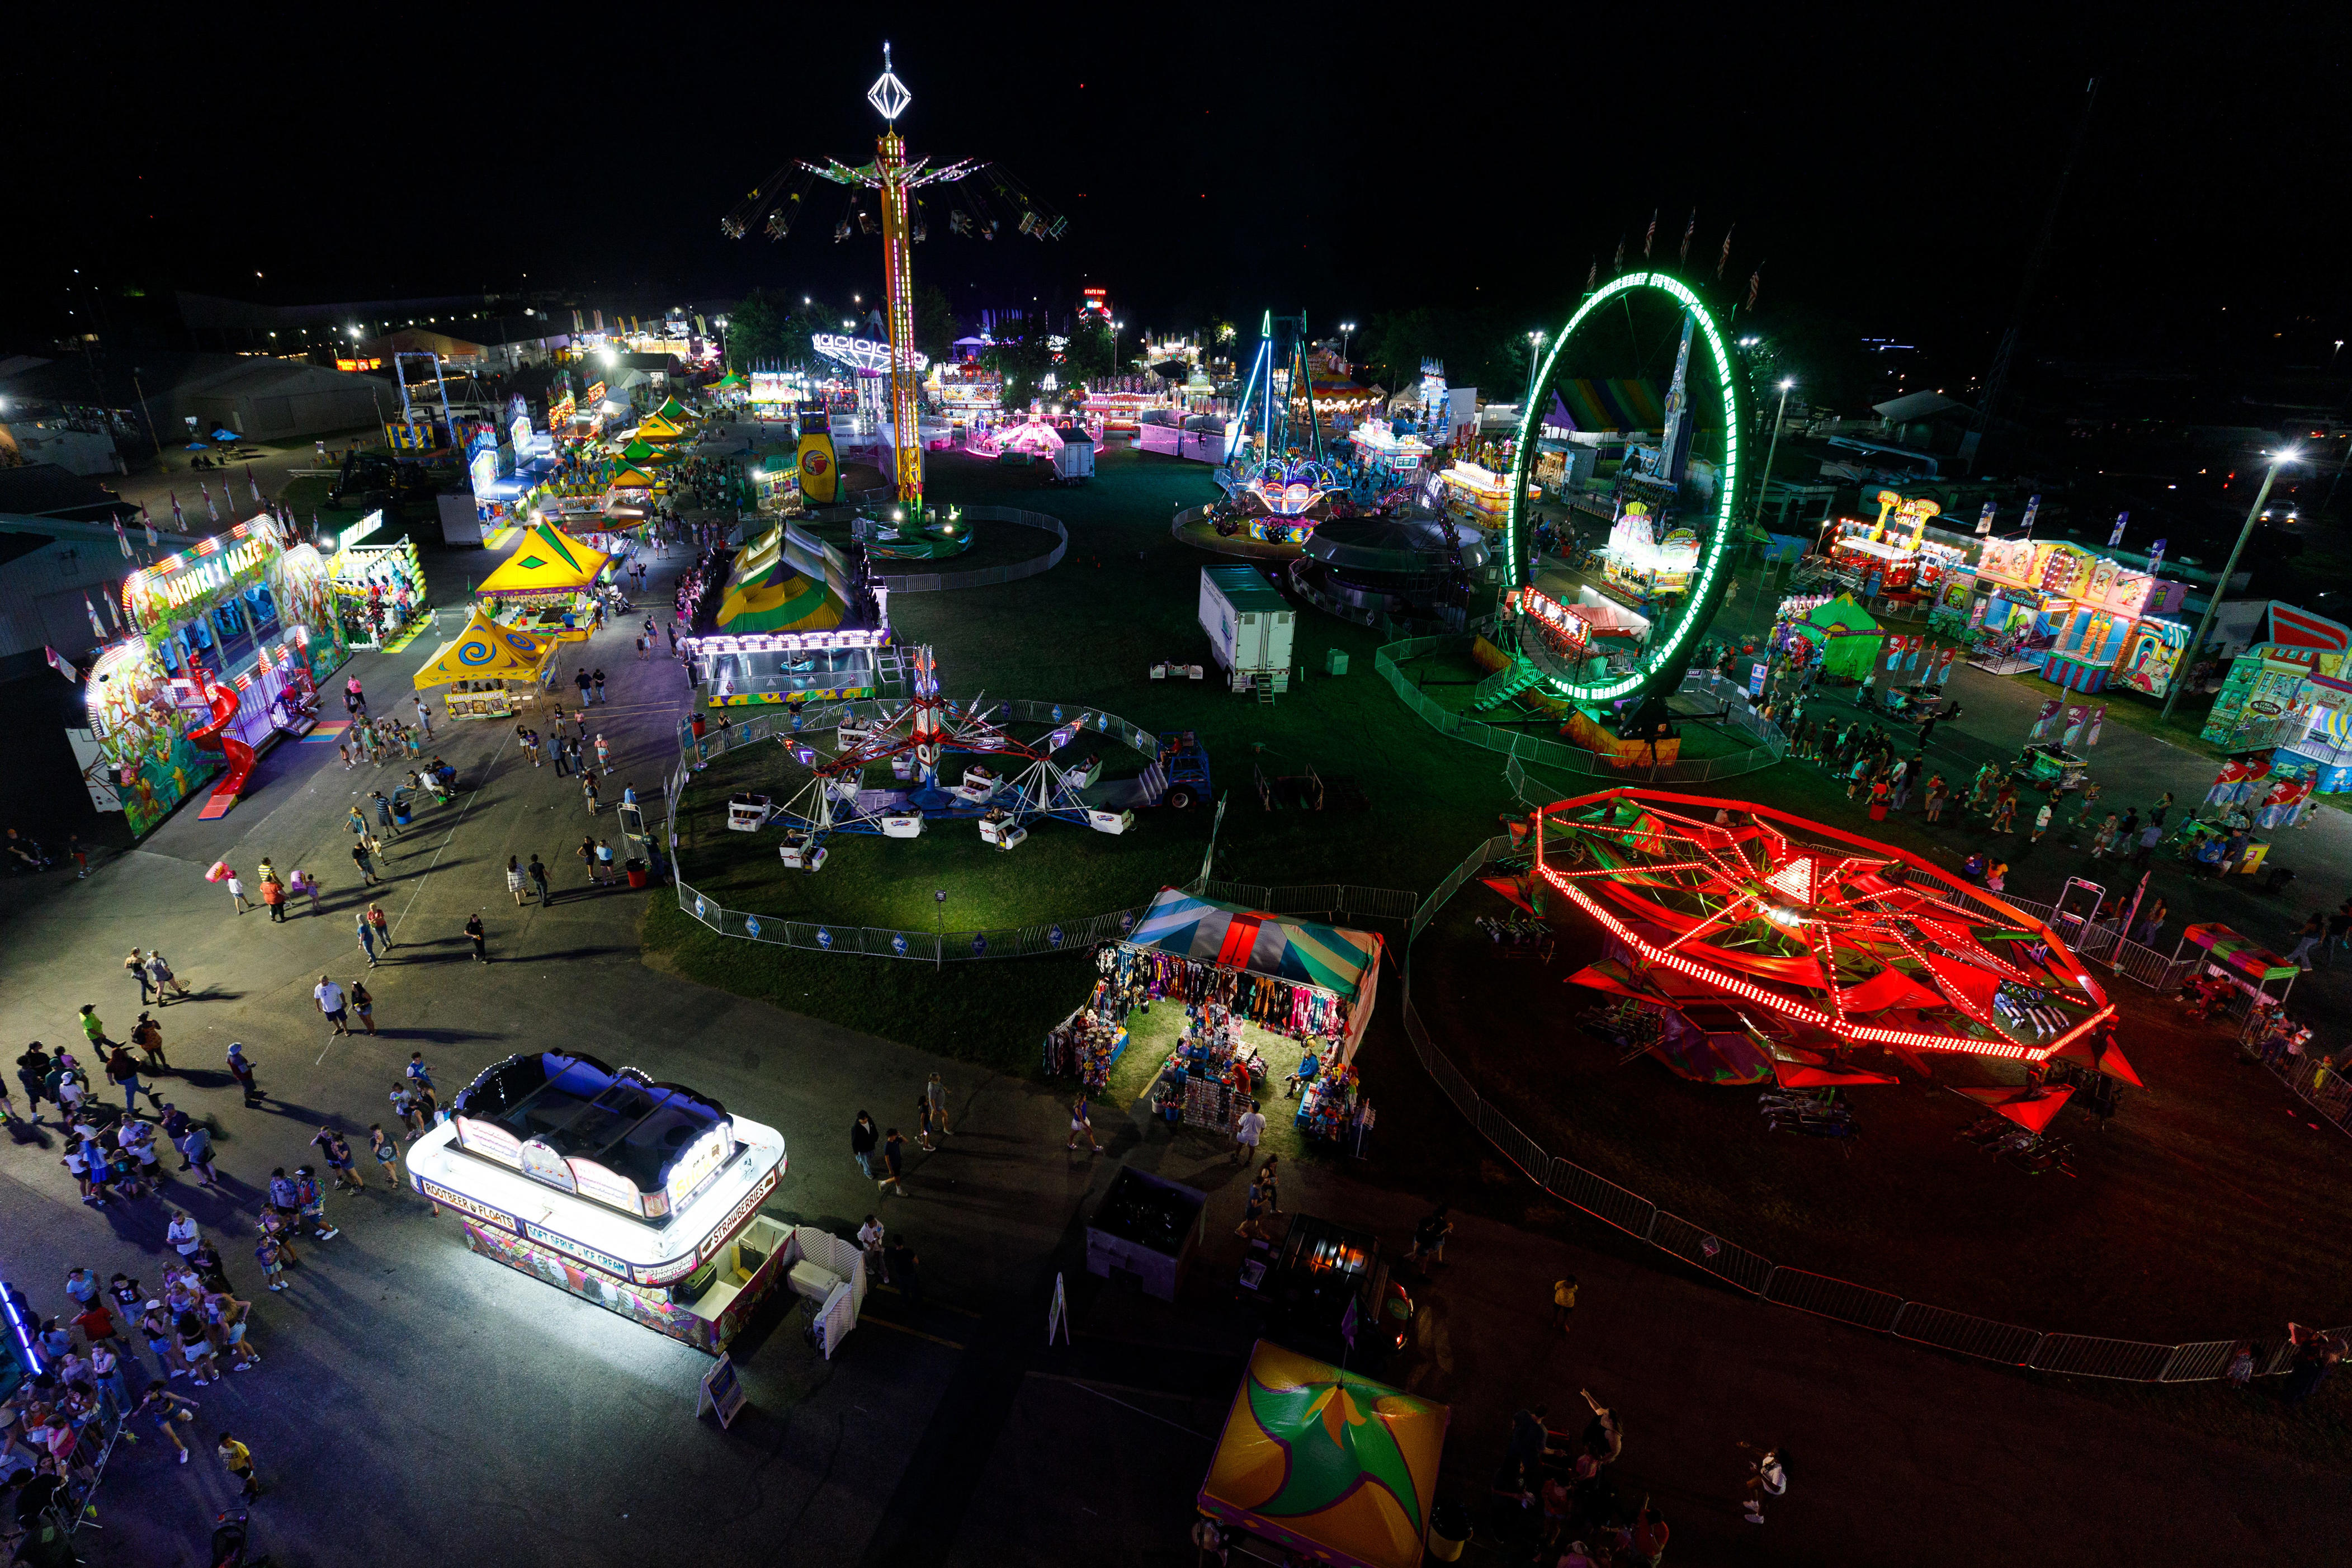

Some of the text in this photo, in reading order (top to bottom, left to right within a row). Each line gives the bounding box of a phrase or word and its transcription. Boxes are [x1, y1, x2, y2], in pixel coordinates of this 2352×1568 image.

[1879, 492, 1898, 503] FIRE
[1915, 501, 1938, 512] HOUSE
[225, 539, 263, 577] MAZE
[2005, 592, 2037, 608] ToonTown
[447, 691, 504, 702] CARICATURES
[425, 1182, 514, 1229] ROOTBEER FLOATS
[713, 1186, 764, 1244] STRAWBERRIES
[528, 1225, 626, 1273] SOFT SERVE ICE CREAM
[653, 1260, 694, 1281] SHORTCAKE
